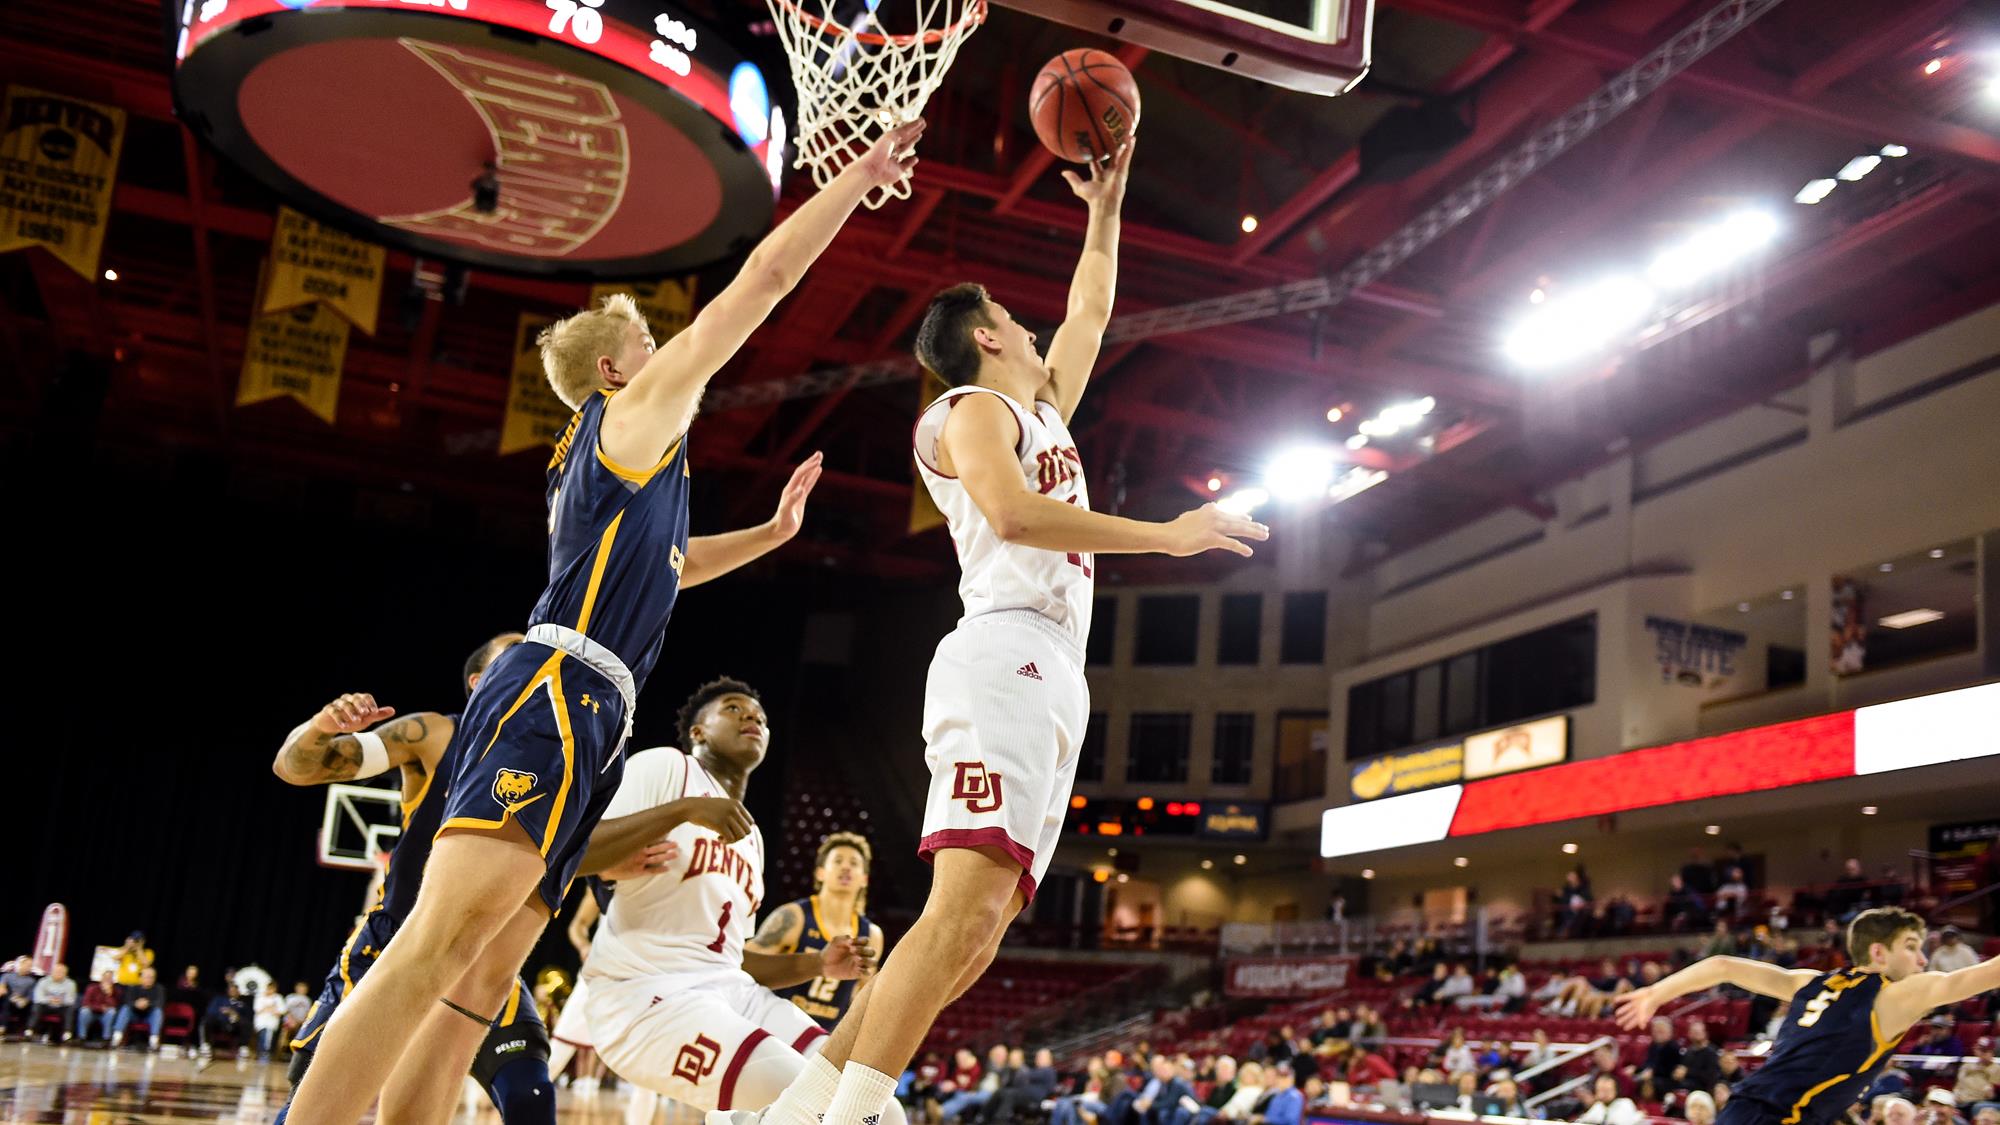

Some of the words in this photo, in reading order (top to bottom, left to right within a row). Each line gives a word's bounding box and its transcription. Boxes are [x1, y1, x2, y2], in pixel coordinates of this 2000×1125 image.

[4, 175, 95, 208] NATIONAL
[1016, 669, 1043, 681] adidas
[707, 900, 732, 954] 1
[808, 976, 840, 1002] 12
[1797, 989, 1842, 1028] 5
